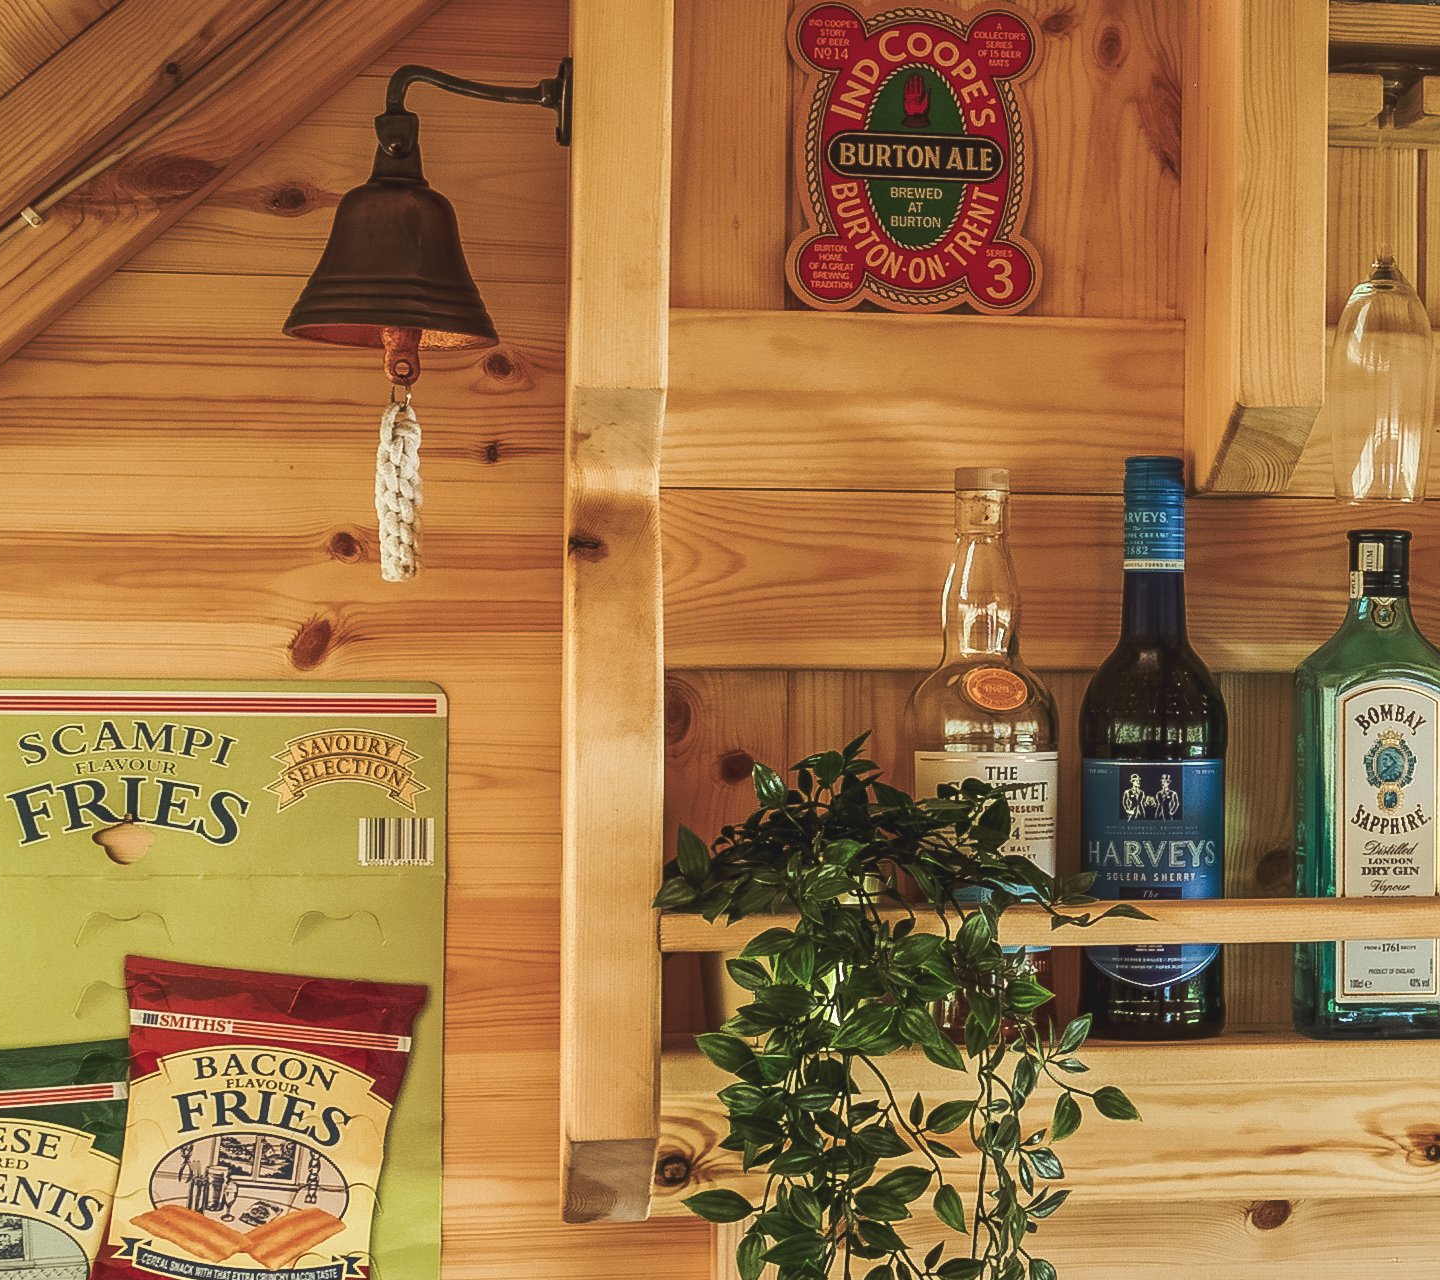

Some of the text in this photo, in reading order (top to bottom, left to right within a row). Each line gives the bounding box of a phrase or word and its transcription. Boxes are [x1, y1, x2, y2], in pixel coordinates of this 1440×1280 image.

[820, 28, 847, 37] STORY
[829, 38, 850, 46] BEER
[834, 48, 849, 60] 14
[830, 30, 997, 127] IND COOPE'S
[839, 142, 994, 171] BURTON ALE
[890, 186, 943, 200] BREWED
[907, 200, 924, 213] AT
[890, 216, 942, 229] BURTON
[819, 253, 842, 261] HOME
[986, 249, 1013, 258] SERIES
[829, 263, 855, 271] GREAT
[986, 259, 1014, 299] 3
[1354, 703, 1428, 737] BOMBAY
[18, 720, 239, 768] SCAMPI
[296, 734, 399, 759] SAVOURY
[75, 758, 179, 775] FLAVOUR
[287, 758, 406, 788] SELECTION
[985, 766, 1018, 782] THE
[6, 775, 251, 848] FRIES
[1089, 840, 1216, 868] HARVEYS
[1362, 840, 1420, 856] Distilled
[1368, 857, 1414, 865] LONDON
[1106, 873, 1196, 882] SOLERA SHERRY
[1361, 866, 1420, 876] DRY GIN
[1370, 879, 1411, 896] Vapour
[1381, 943, 1400, 953] 1761
[192, 1053, 339, 1092] BACON
[226, 1078, 300, 1096] FLAVOUR
[171, 1089, 352, 1147] FRIES
[140, 1252, 168, 1270] CEREAL
[169, 1261, 195, 1276] SNACK
[195, 1267, 212, 1279] WITH
[213, 1269, 230, 1280] THAT
[316, 1268, 339, 1280] TASTE
